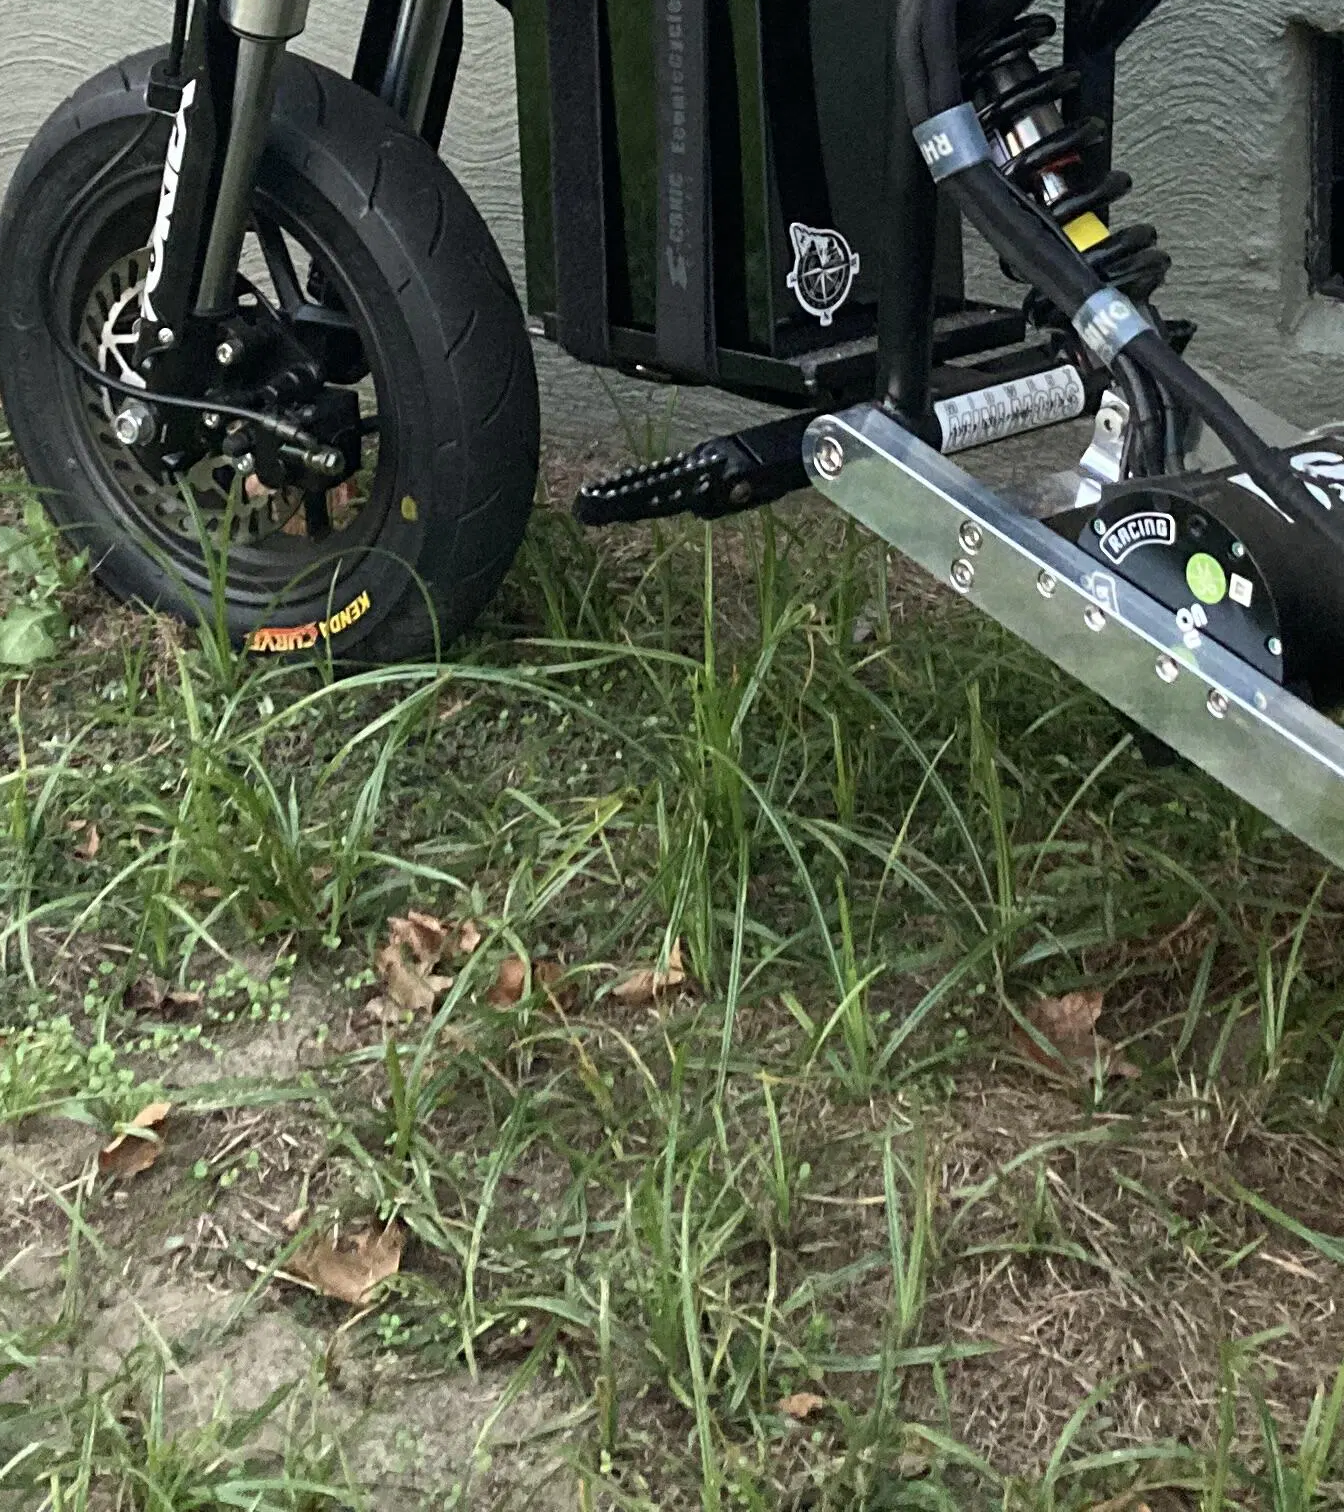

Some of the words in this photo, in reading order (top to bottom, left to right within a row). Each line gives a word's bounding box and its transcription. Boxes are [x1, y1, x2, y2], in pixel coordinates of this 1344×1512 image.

[919, 132, 954, 166] RH
[945, 401, 1006, 450] MINI
[1006, 381, 1079, 429] MODS
[1107, 518, 1168, 554] RACING
[318, 590, 371, 638] KENDA
